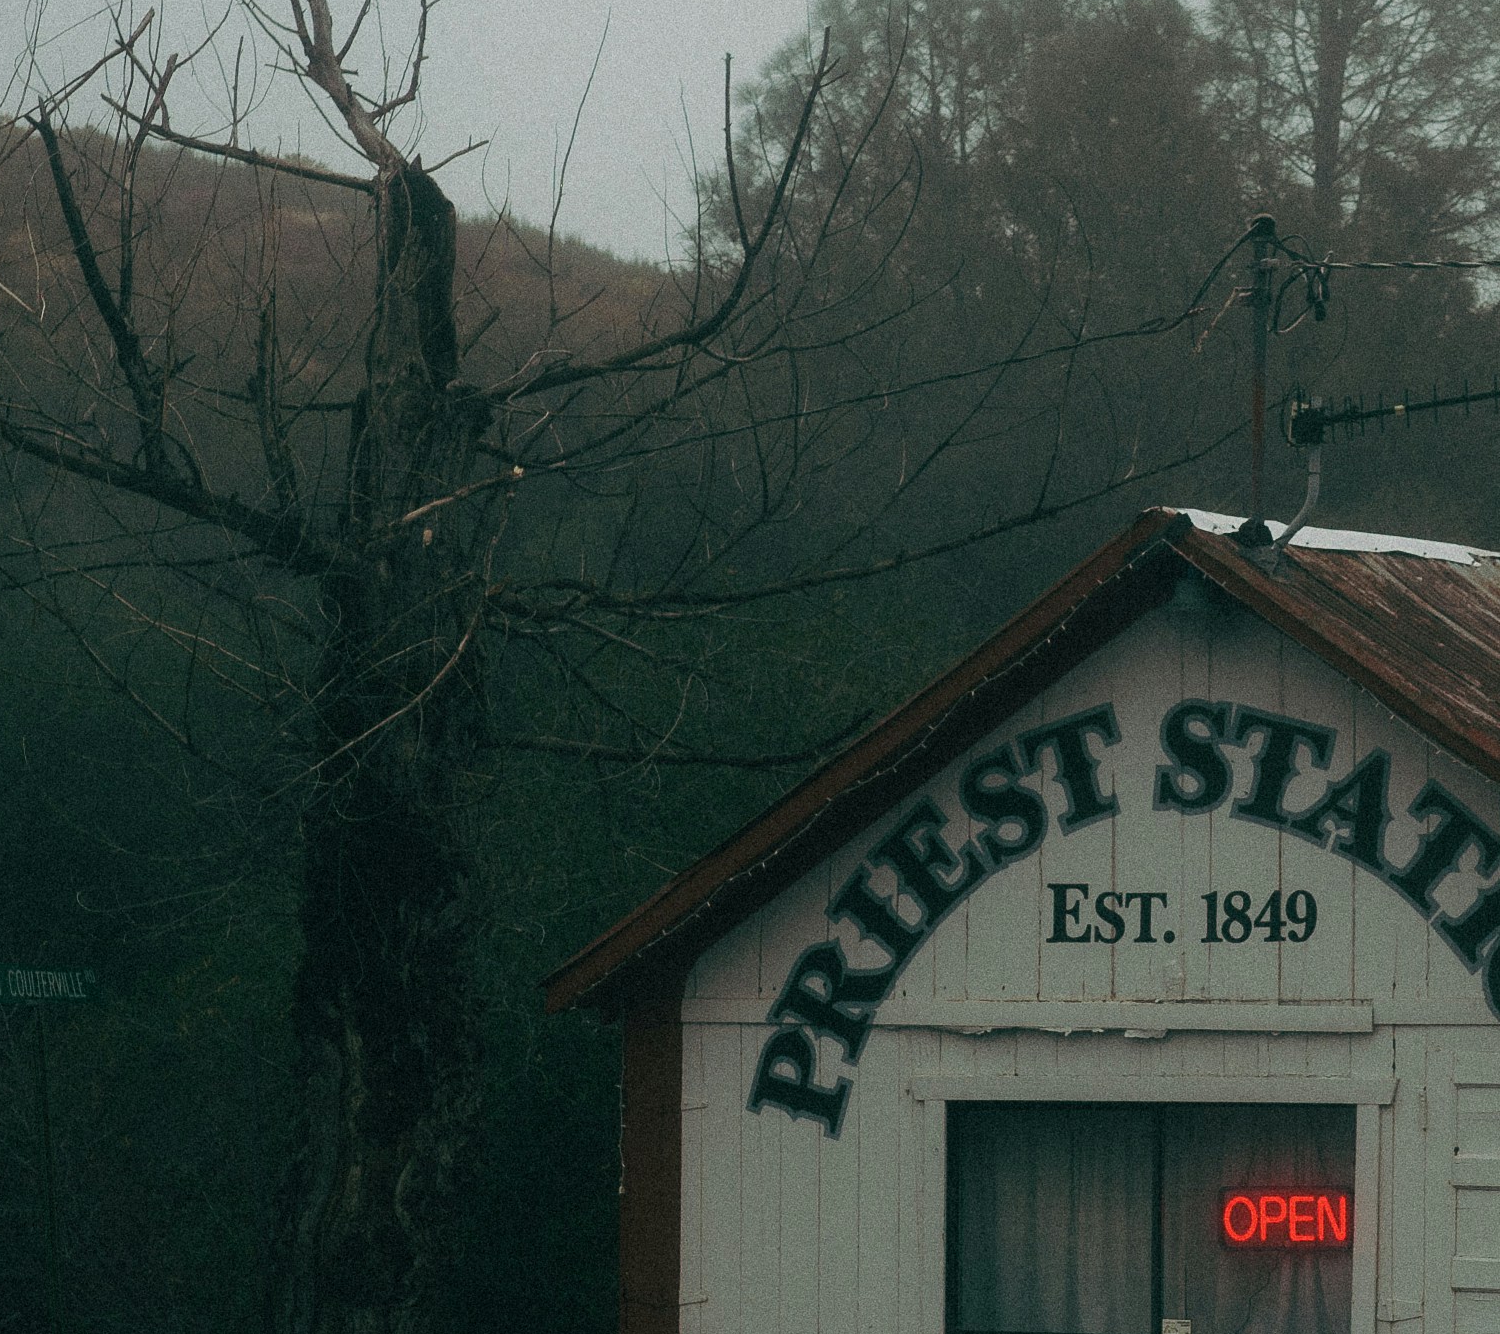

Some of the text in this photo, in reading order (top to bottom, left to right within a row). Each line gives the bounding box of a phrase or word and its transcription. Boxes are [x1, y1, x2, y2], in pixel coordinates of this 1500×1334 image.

[745, 702, 1122, 1140] PRIEST
[1201, 890, 1318, 943] 1849
[7, 969, 86, 998] COULTERVILLE
[1223, 1196, 1346, 1241] OPEN
